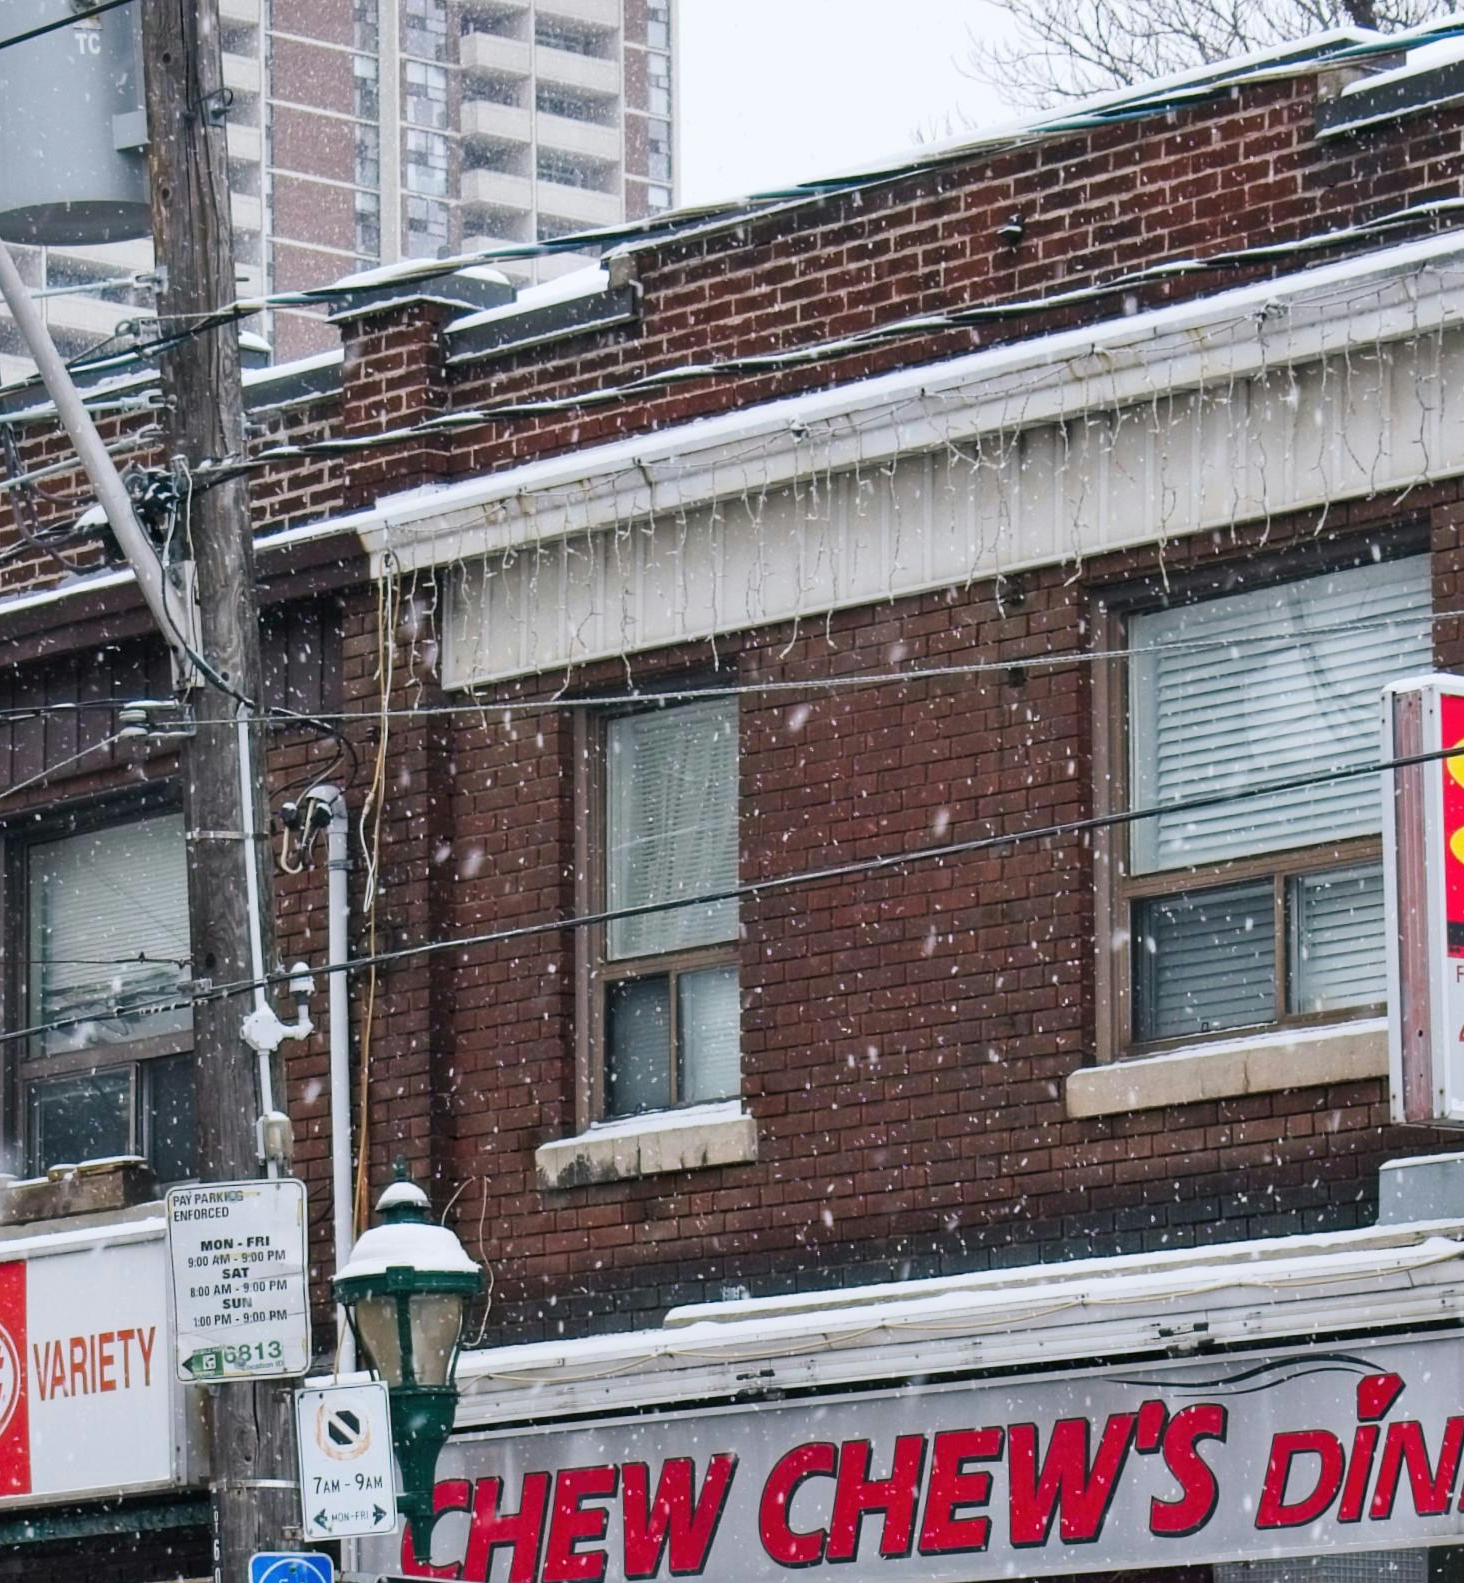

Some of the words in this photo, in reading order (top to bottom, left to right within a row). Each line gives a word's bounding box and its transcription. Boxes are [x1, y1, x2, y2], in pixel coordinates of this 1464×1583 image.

[75, 33, 101, 55] TC
[172, 1192, 193, 1207] PAY
[173, 1206, 230, 1222] ENFORCED
[200, 1239, 233, 1252] MON
[246, 1236, 270, 1248] FRI
[187, 1257, 209, 1269] 9:00
[212, 1253, 230, 1265] AM
[241, 1251, 265, 1264] 9:00
[267, 1249, 286, 1262] PM
[222, 1267, 250, 1280] SAT
[190, 1286, 210, 1298] 8:00
[213, 1283, 232, 1296] AM
[243, 1281, 266, 1293] 9:00
[269, 1279, 288, 1291] PM
[222, 1297, 253, 1310] SUN
[193, 1317, 212, 1328] 1:00
[214, 1314, 232, 1326] PM
[243, 1311, 266, 1324] 9:00
[269, 1309, 288, 1321] PM
[224, 1340, 283, 1364] 6813
[33, 1327, 157, 1402] VARIETY
[313, 1476, 341, 1495] 7AM
[354, 1472, 383, 1491] 9AM
[758, 1398, 1229, 1570] CHEW'S
[331, 1509, 369, 1523] MON-FRI
